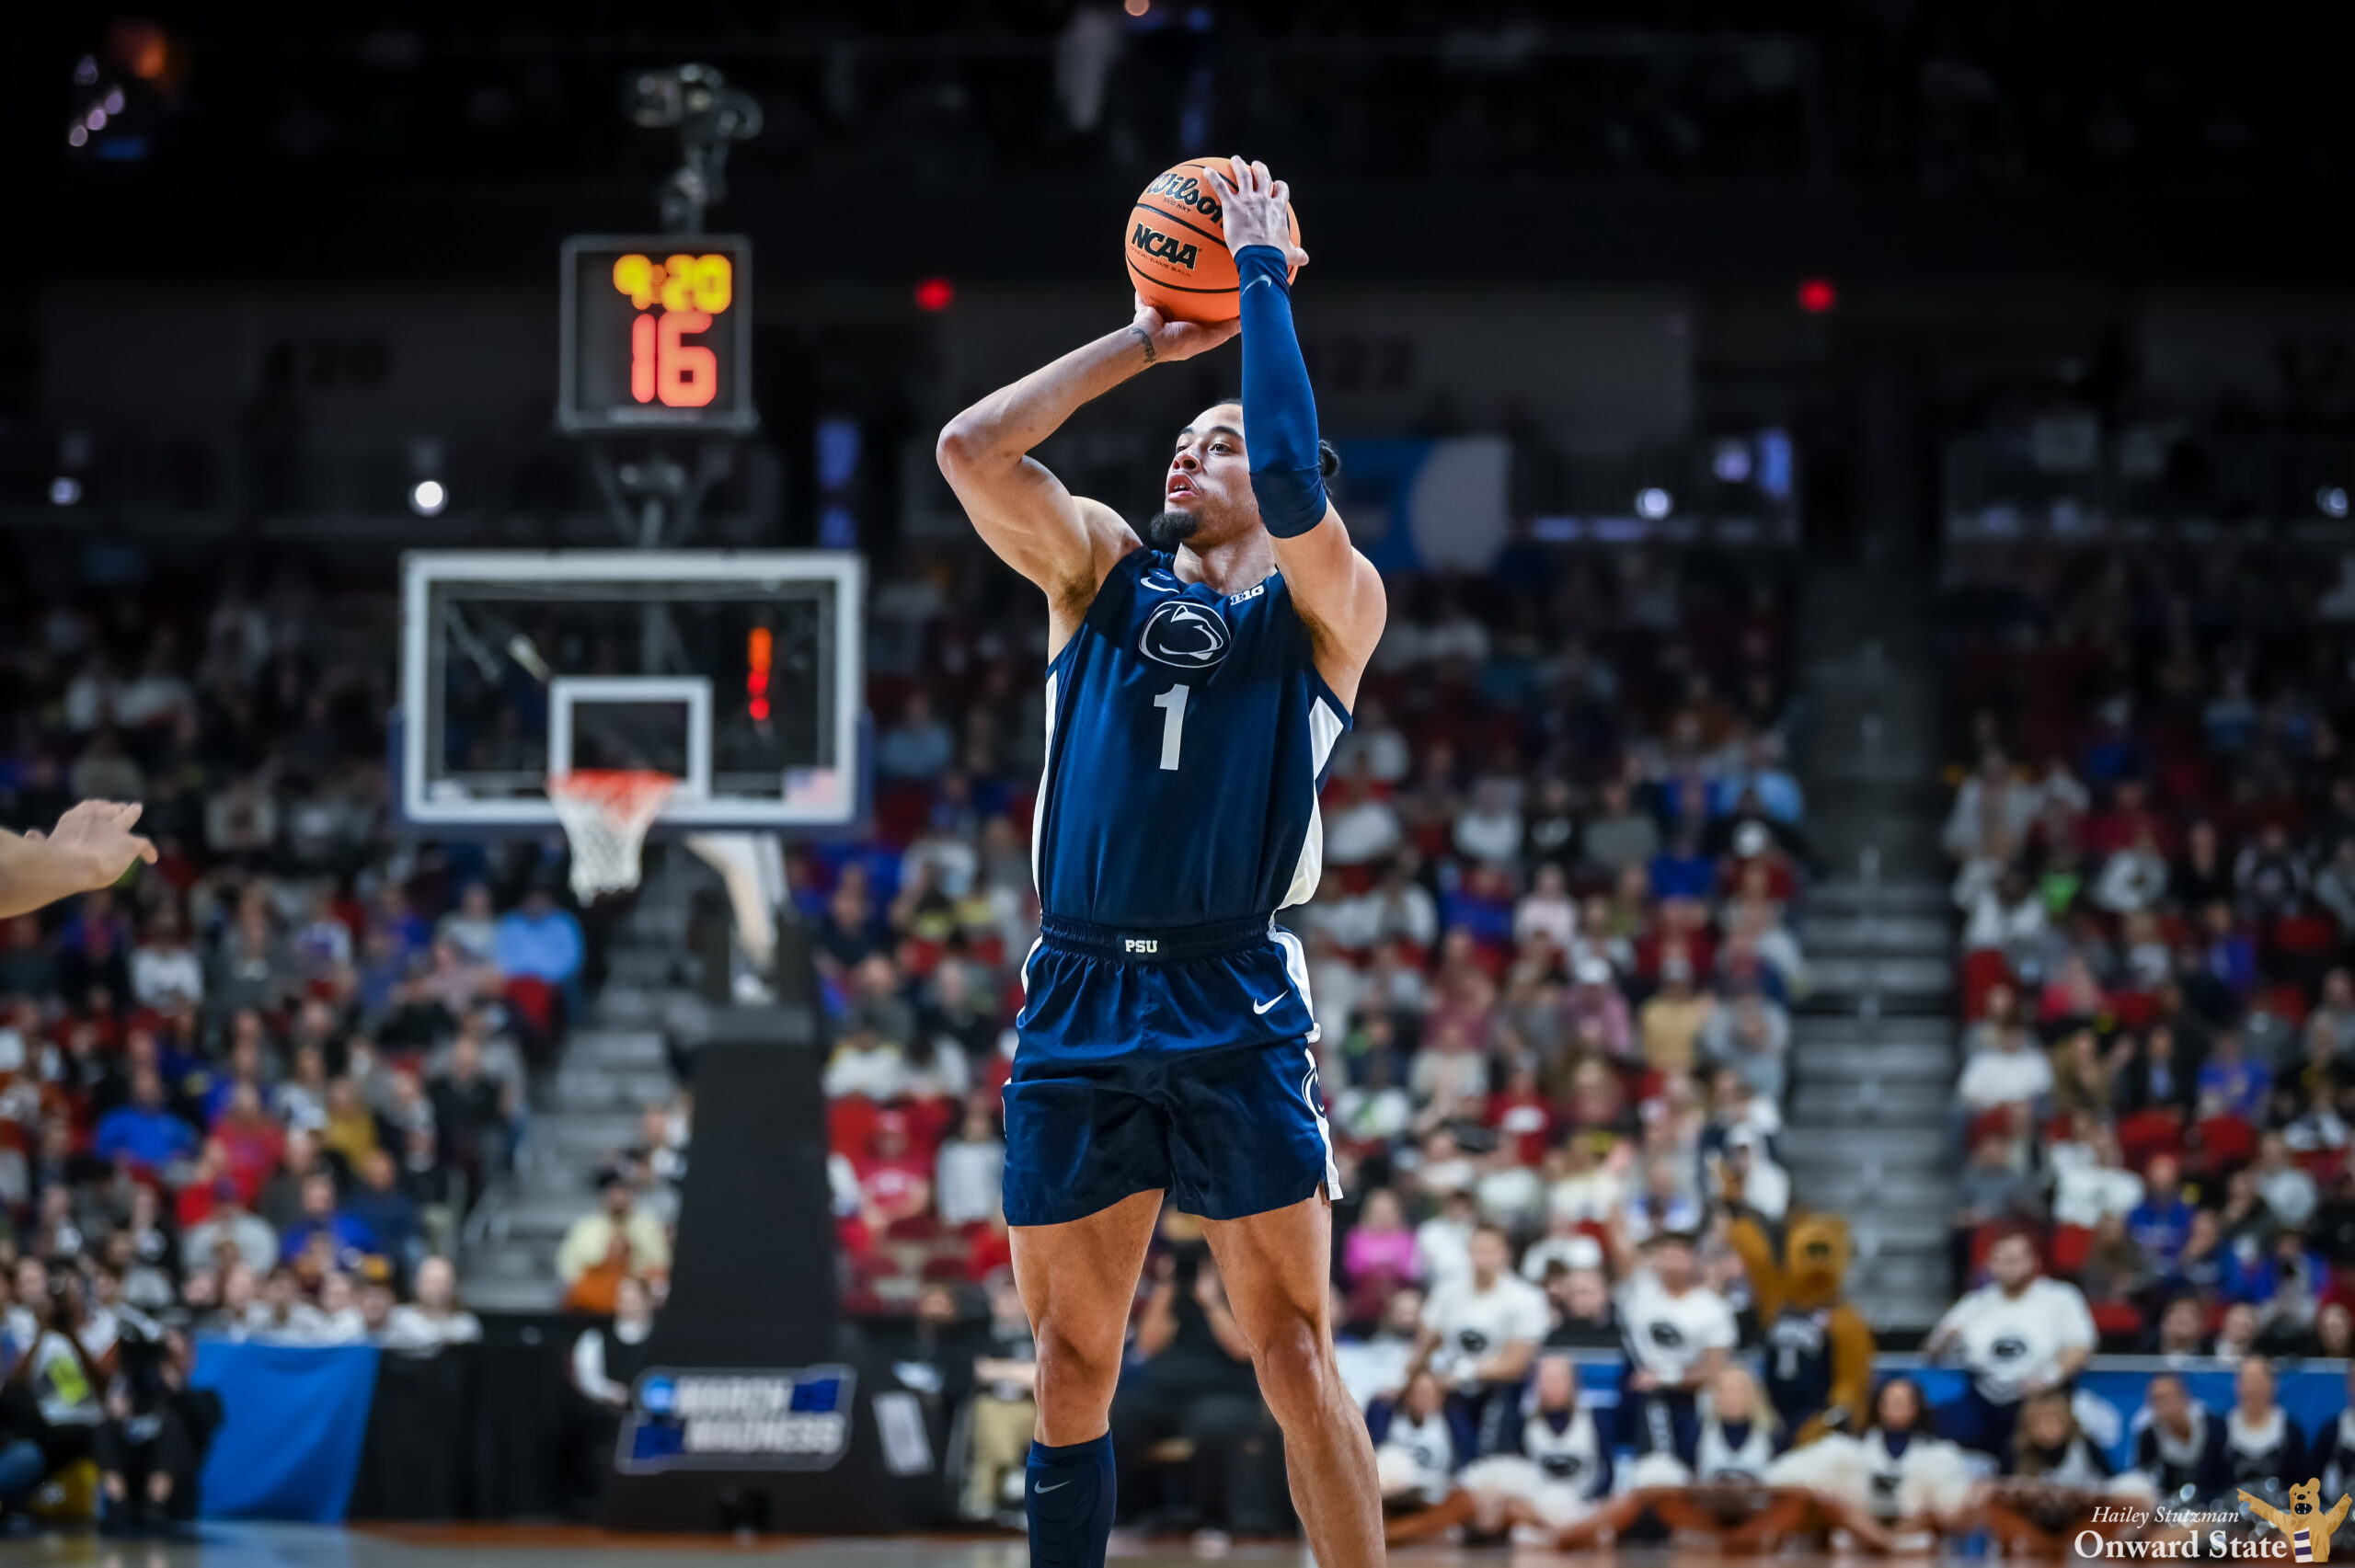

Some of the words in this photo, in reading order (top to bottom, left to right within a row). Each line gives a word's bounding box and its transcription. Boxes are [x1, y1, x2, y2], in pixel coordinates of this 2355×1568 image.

[1131, 221, 1198, 270] NCAA
[614, 254, 732, 315] 9:20
[632, 310, 717, 407] 16
[1154, 683, 1189, 771] 1
[1125, 939, 1158, 954] PSU
